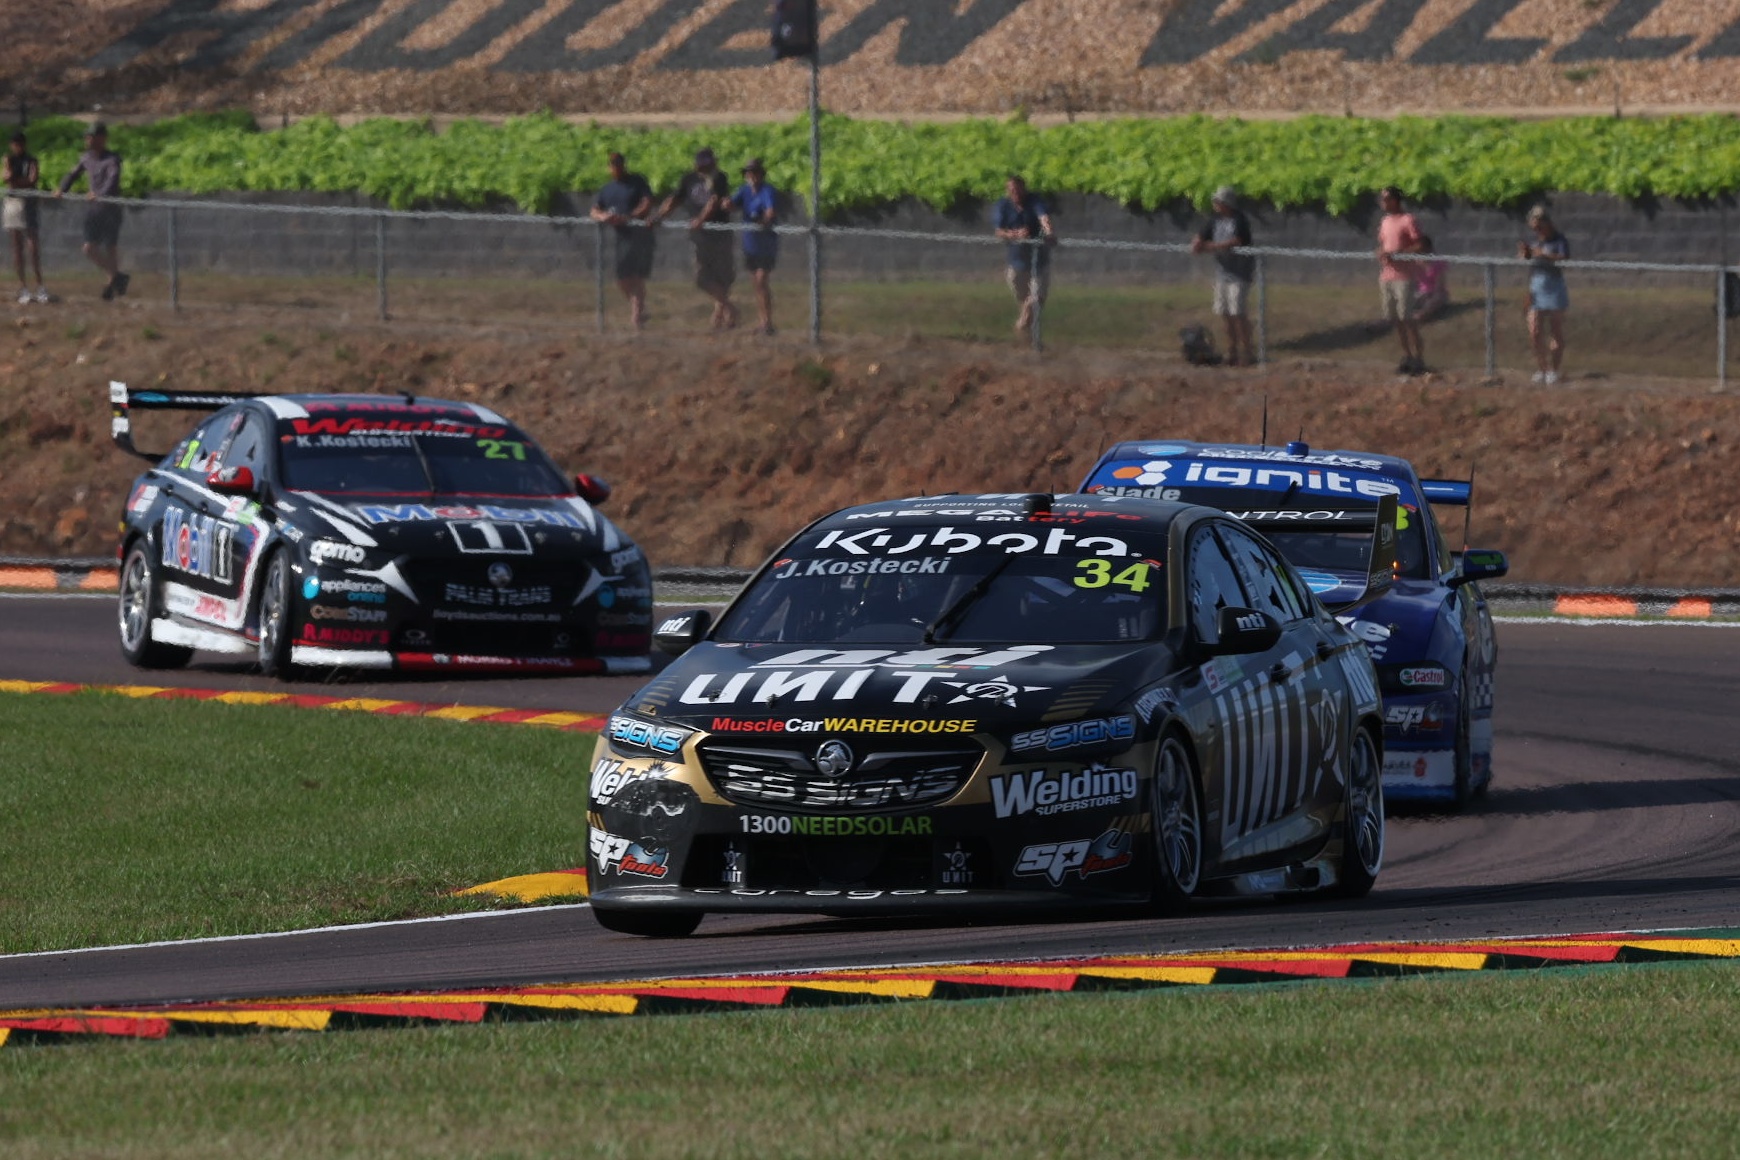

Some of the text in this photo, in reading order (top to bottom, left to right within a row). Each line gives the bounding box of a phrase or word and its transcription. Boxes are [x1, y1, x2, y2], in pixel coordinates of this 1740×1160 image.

[476, 439, 527, 461] 27
[1185, 462, 1402, 498] ignite
[1224, 511, 1353, 520] NTROL
[815, 527, 1128, 557] Kubota
[776, 556, 951, 579] J.Kostecki
[1073, 558, 1150, 592] 34
[1235, 611, 1267, 631] nti
[678, 668, 958, 705] UNIT
[1413, 670, 1443, 683] Castrol
[989, 765, 1138, 819] Welding
[1035, 794, 1122, 816] SUPERSTORE
